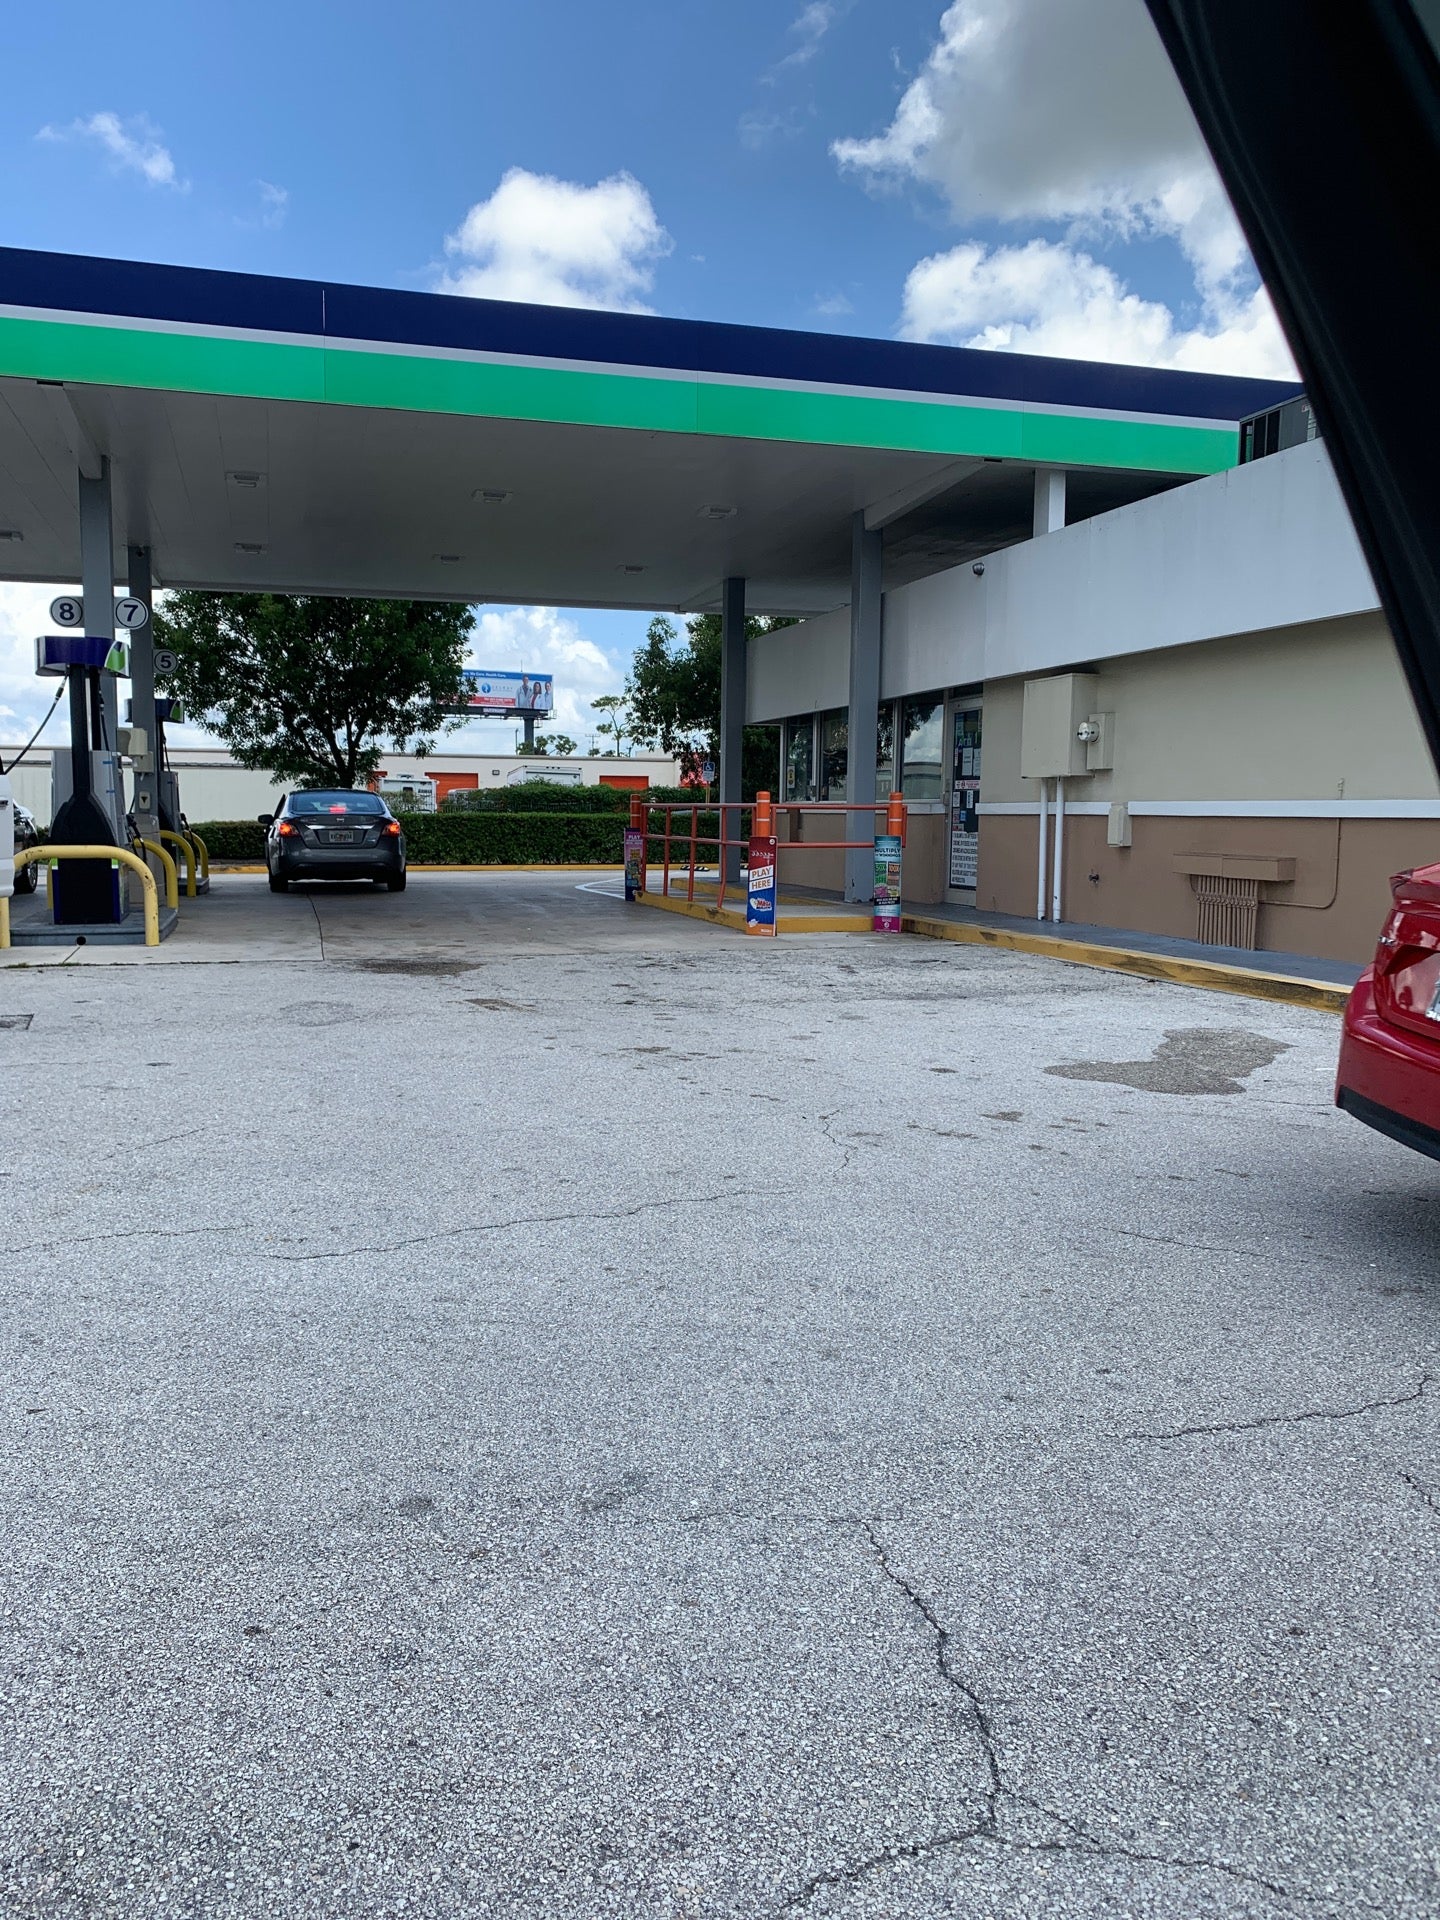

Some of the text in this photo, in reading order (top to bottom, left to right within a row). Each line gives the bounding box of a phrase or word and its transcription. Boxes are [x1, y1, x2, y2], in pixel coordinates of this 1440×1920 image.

[60, 603, 75, 621] 8
[123, 604, 139, 622] 7
[160, 655, 172, 669] 5
[751, 867, 772, 879] PLAY
[751, 879, 771, 891] HERE
